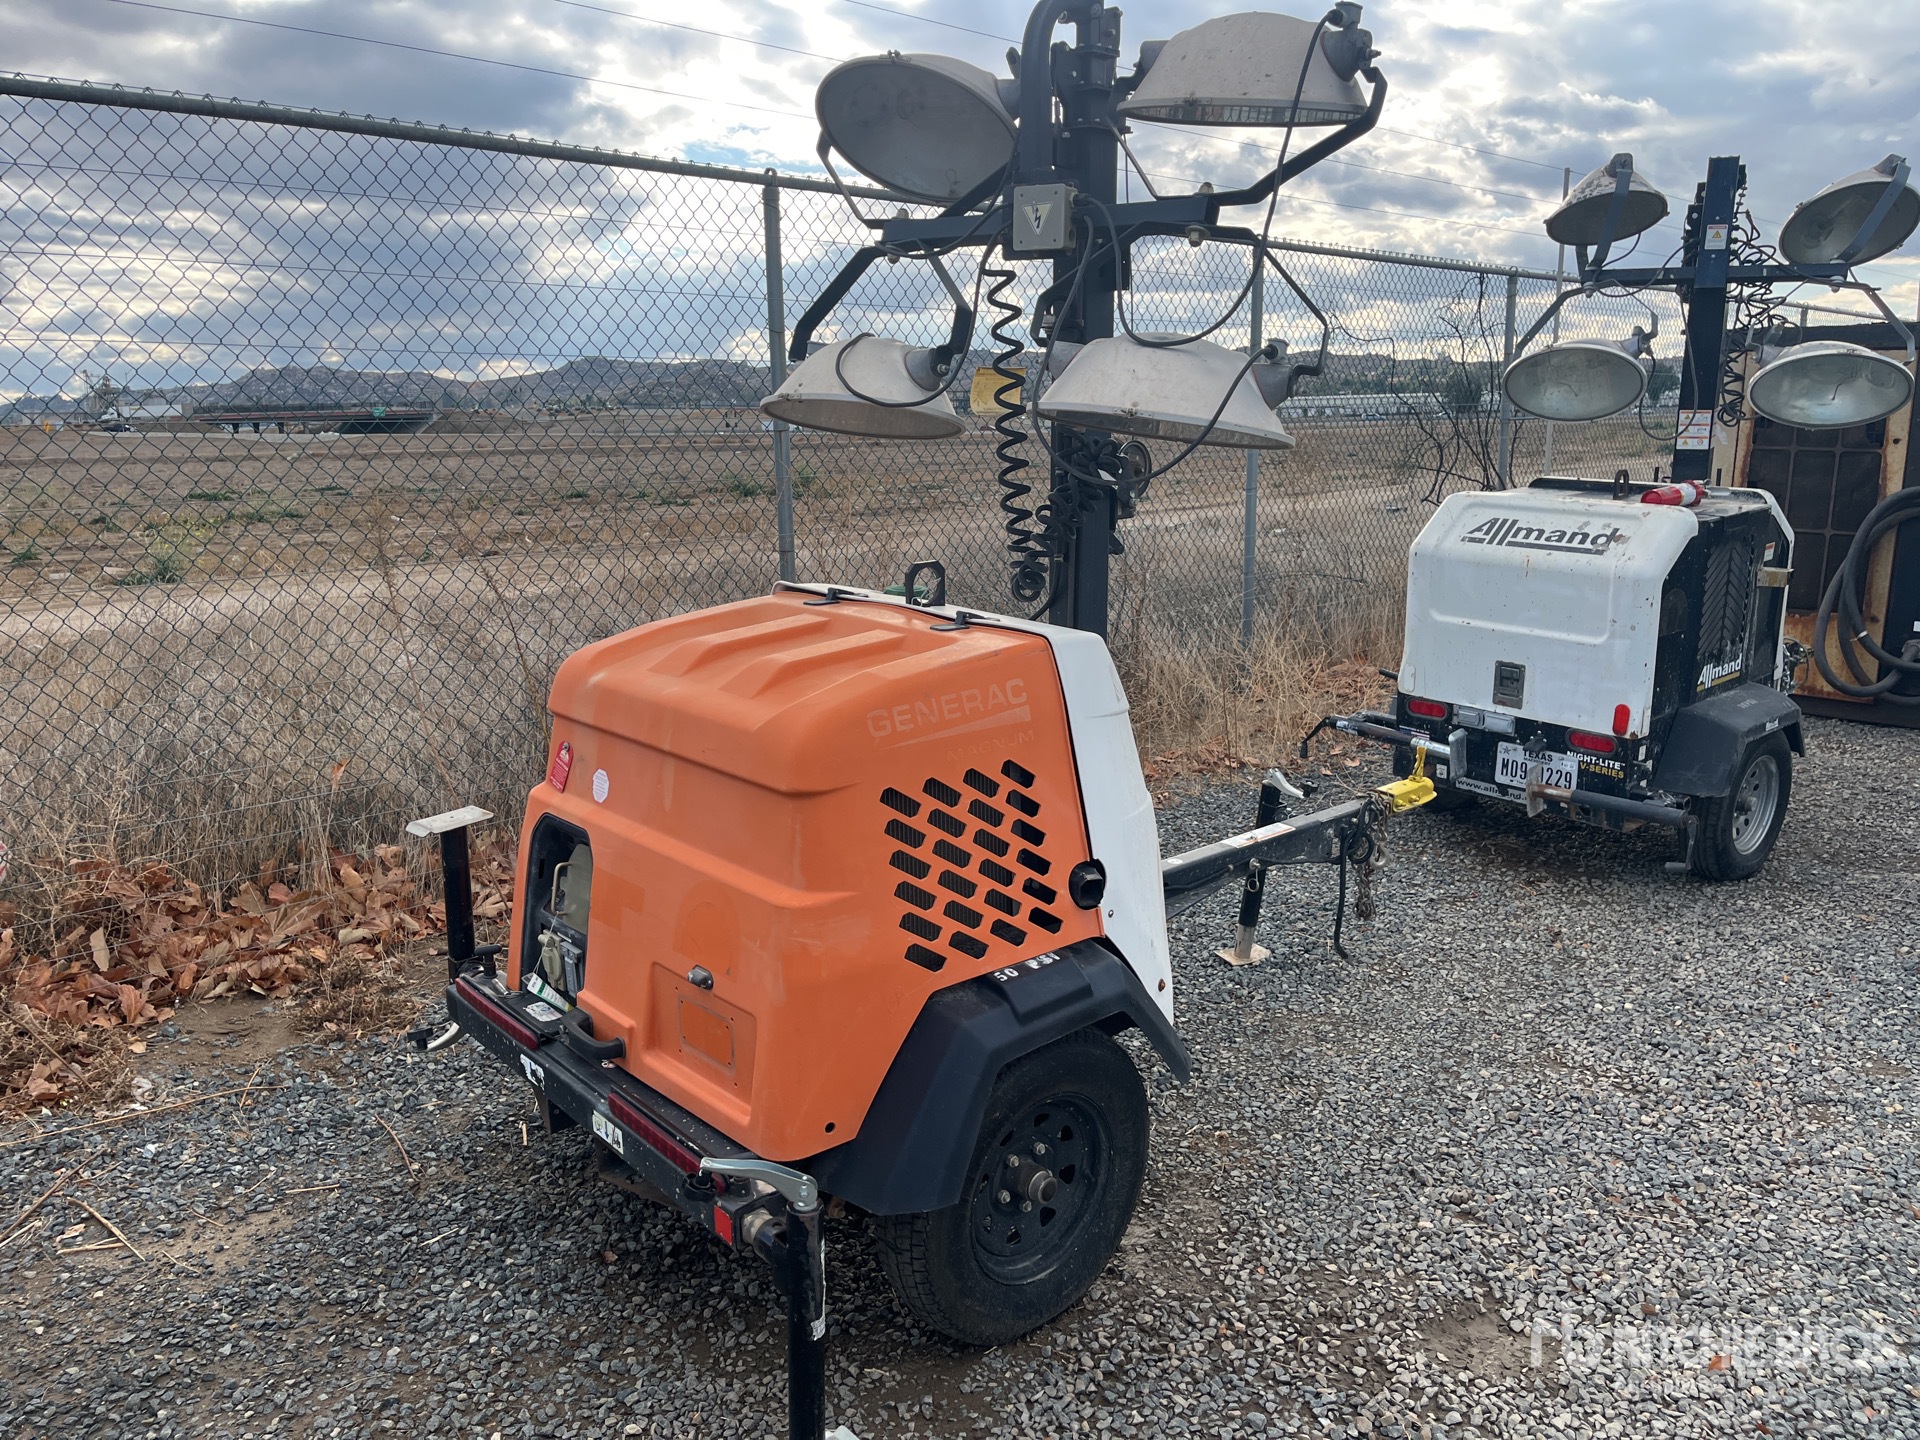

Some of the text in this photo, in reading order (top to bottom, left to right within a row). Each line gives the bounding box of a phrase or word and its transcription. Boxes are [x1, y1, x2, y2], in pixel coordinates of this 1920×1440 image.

[1466, 517, 1620, 549] Allmand
[1697, 653, 1743, 689] Allmand
[866, 677, 1028, 738] GENERAC
[1523, 749, 1553, 763] TEXAS
[1579, 762, 1625, 779] V-SERIES
[993, 968, 1019, 982] 50
